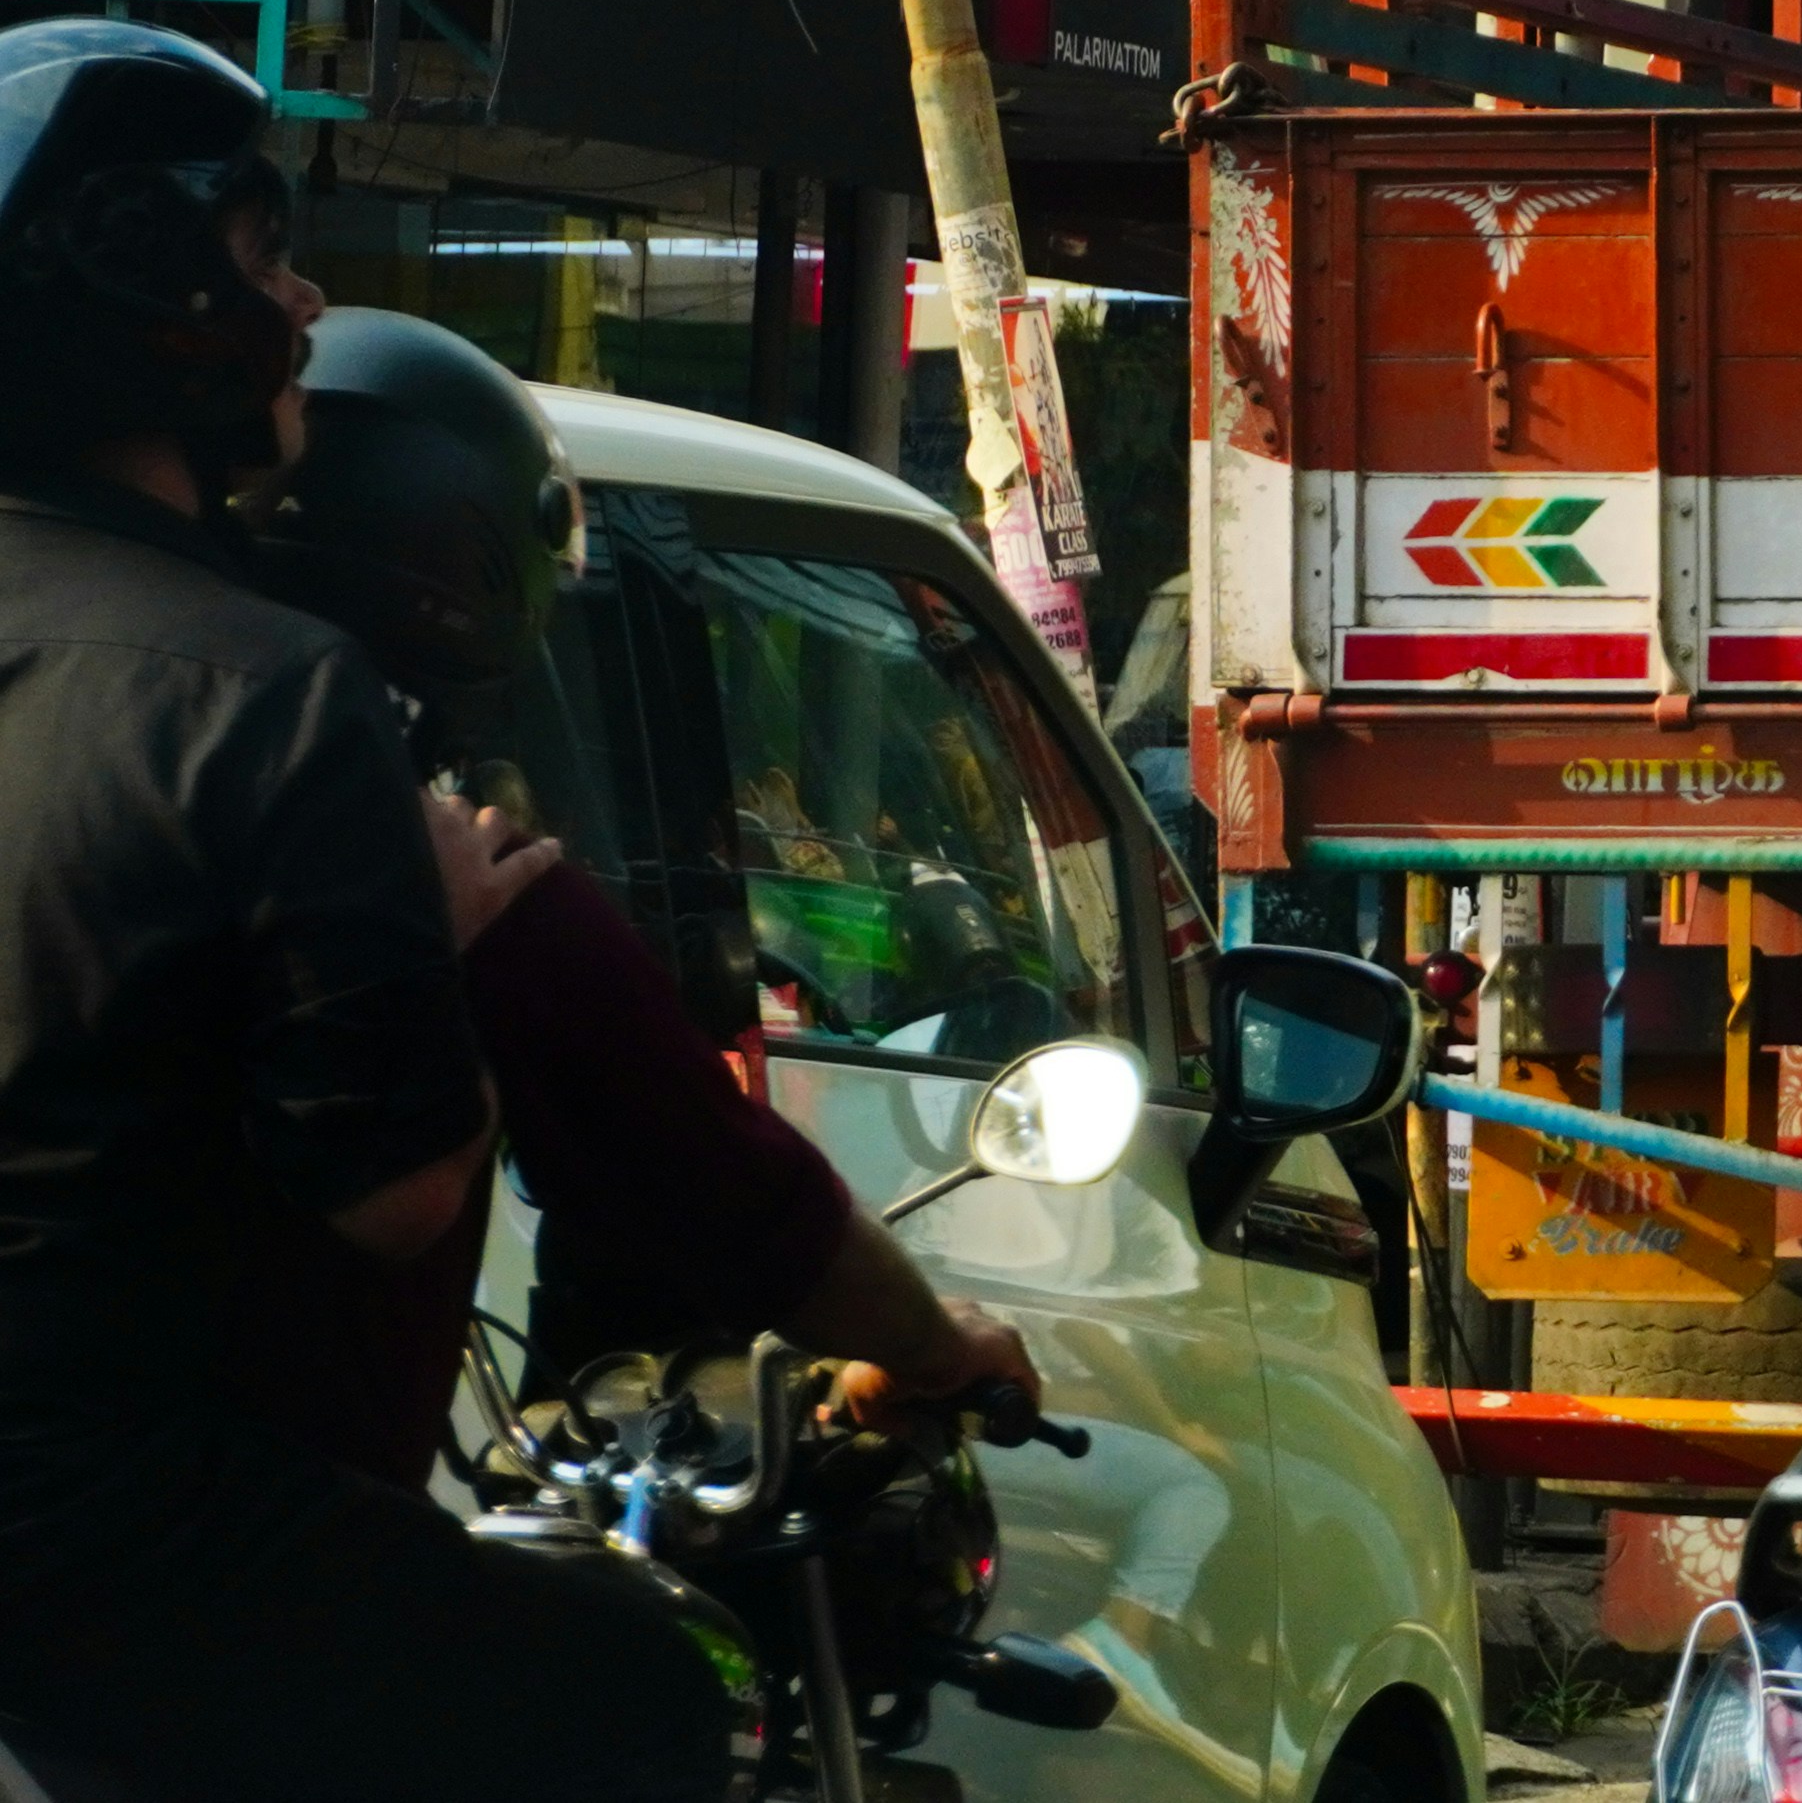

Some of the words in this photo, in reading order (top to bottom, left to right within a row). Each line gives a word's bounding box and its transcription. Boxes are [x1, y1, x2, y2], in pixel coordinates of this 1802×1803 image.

[1053, 29, 1162, 81] PALARIVATTOM
[1041, 500, 1087, 531] KARATE
[1058, 528, 1088, 555] CLASS
